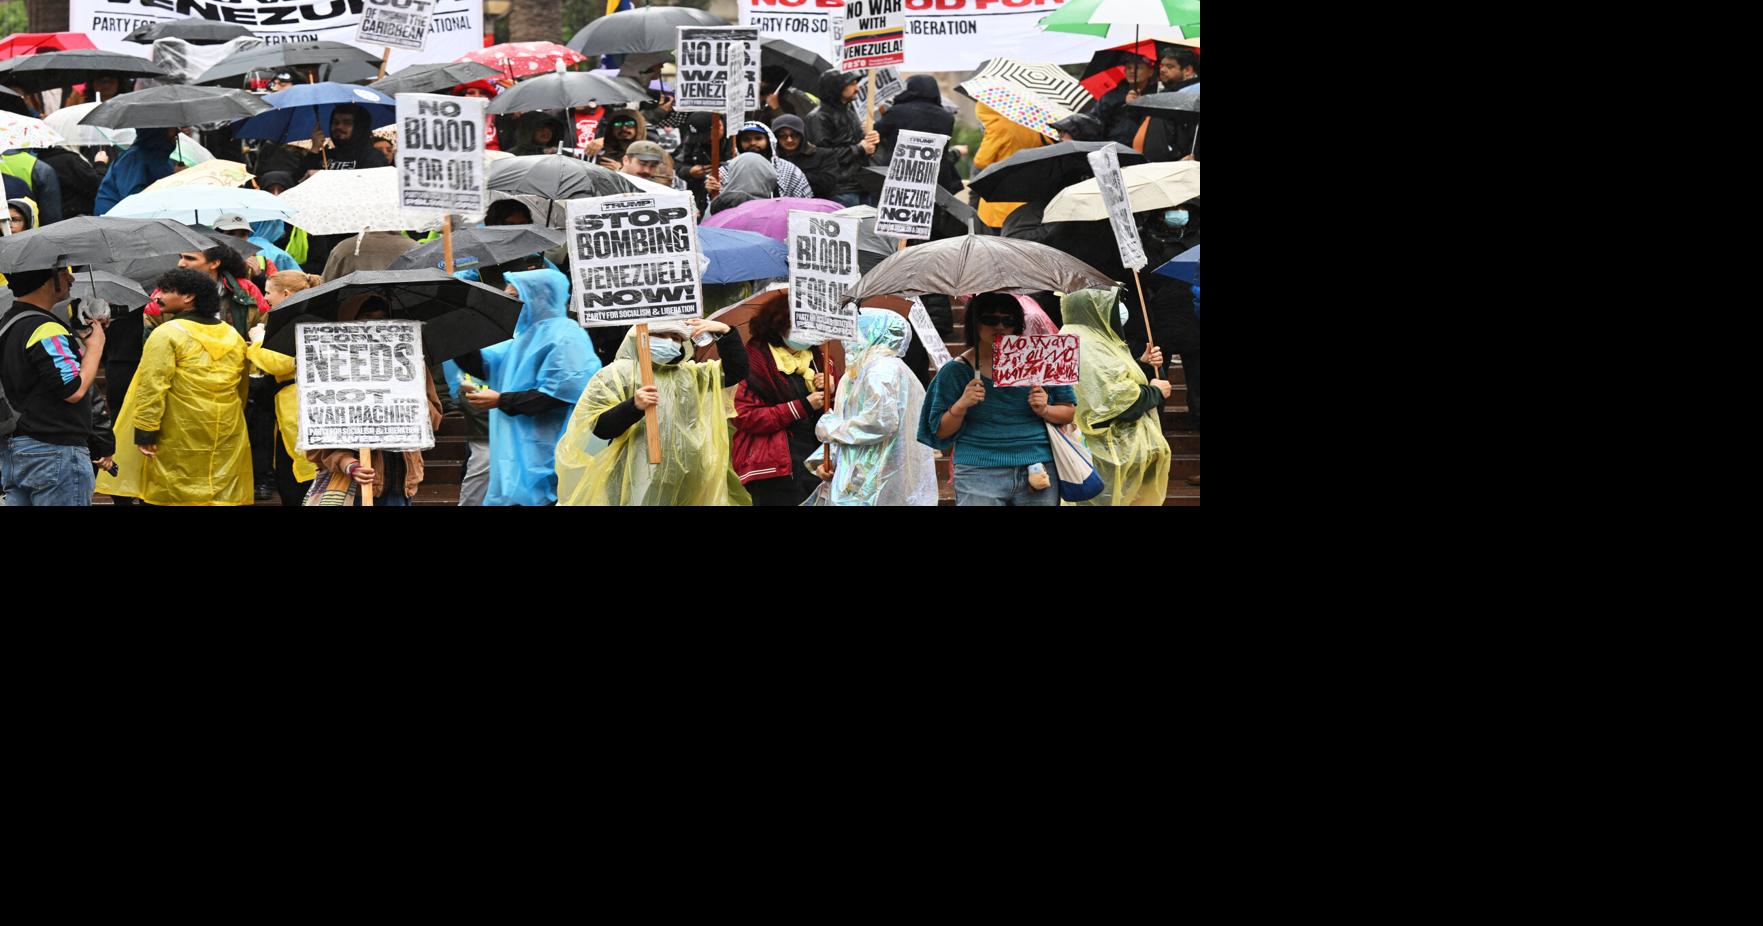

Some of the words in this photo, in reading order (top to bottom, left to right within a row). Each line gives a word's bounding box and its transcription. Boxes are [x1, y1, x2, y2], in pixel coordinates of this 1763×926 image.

[365, 7, 377, 20] OF
[409, 14, 428, 28] THE
[847, 1, 863, 19] NO
[869, 0, 902, 15] WAR
[92, 16, 131, 32] PARTY
[361, 18, 425, 40] CARIBBEAN
[427, 15, 472, 34] ATIONAL
[785, 17, 810, 33] FOR
[859, 16, 886, 30] WITH
[681, 41, 712, 66] NO
[844, 40, 903, 60] VENEZUELA!
[875, 68, 897, 89] OIL
[418, 100, 461, 118] NO
[404, 117, 477, 152] BLOOD
[403, 157, 444, 189] FOR
[447, 159, 480, 192] OIL
[889, 158, 939, 186] BOMBIN
[575, 207, 688, 231] STOP
[809, 217, 840, 238] NO
[576, 225, 690, 260] BOMBING
[797, 235, 852, 275] BLOOD
[580, 260, 695, 290] VENEZUELA
[583, 285, 695, 308] NOW!
[795, 276, 826, 312] FOR
[586, 312, 606, 320] PARTY
[607, 310, 618, 319] FOR
[619, 308, 651, 318] SOCIALISM
[652, 307, 660, 315] &
[661, 304, 695, 315] LIBERATION
[303, 326, 371, 334] MONEY
[375, 325, 414, 333] FOR
[1003, 337, 1027, 351] NO
[1045, 346, 1074, 363] NO
[305, 343, 417, 383] NEEDS
[306, 389, 391, 405] NOT
[307, 406, 346, 424] WAR
[348, 405, 419, 424] MACHINE
